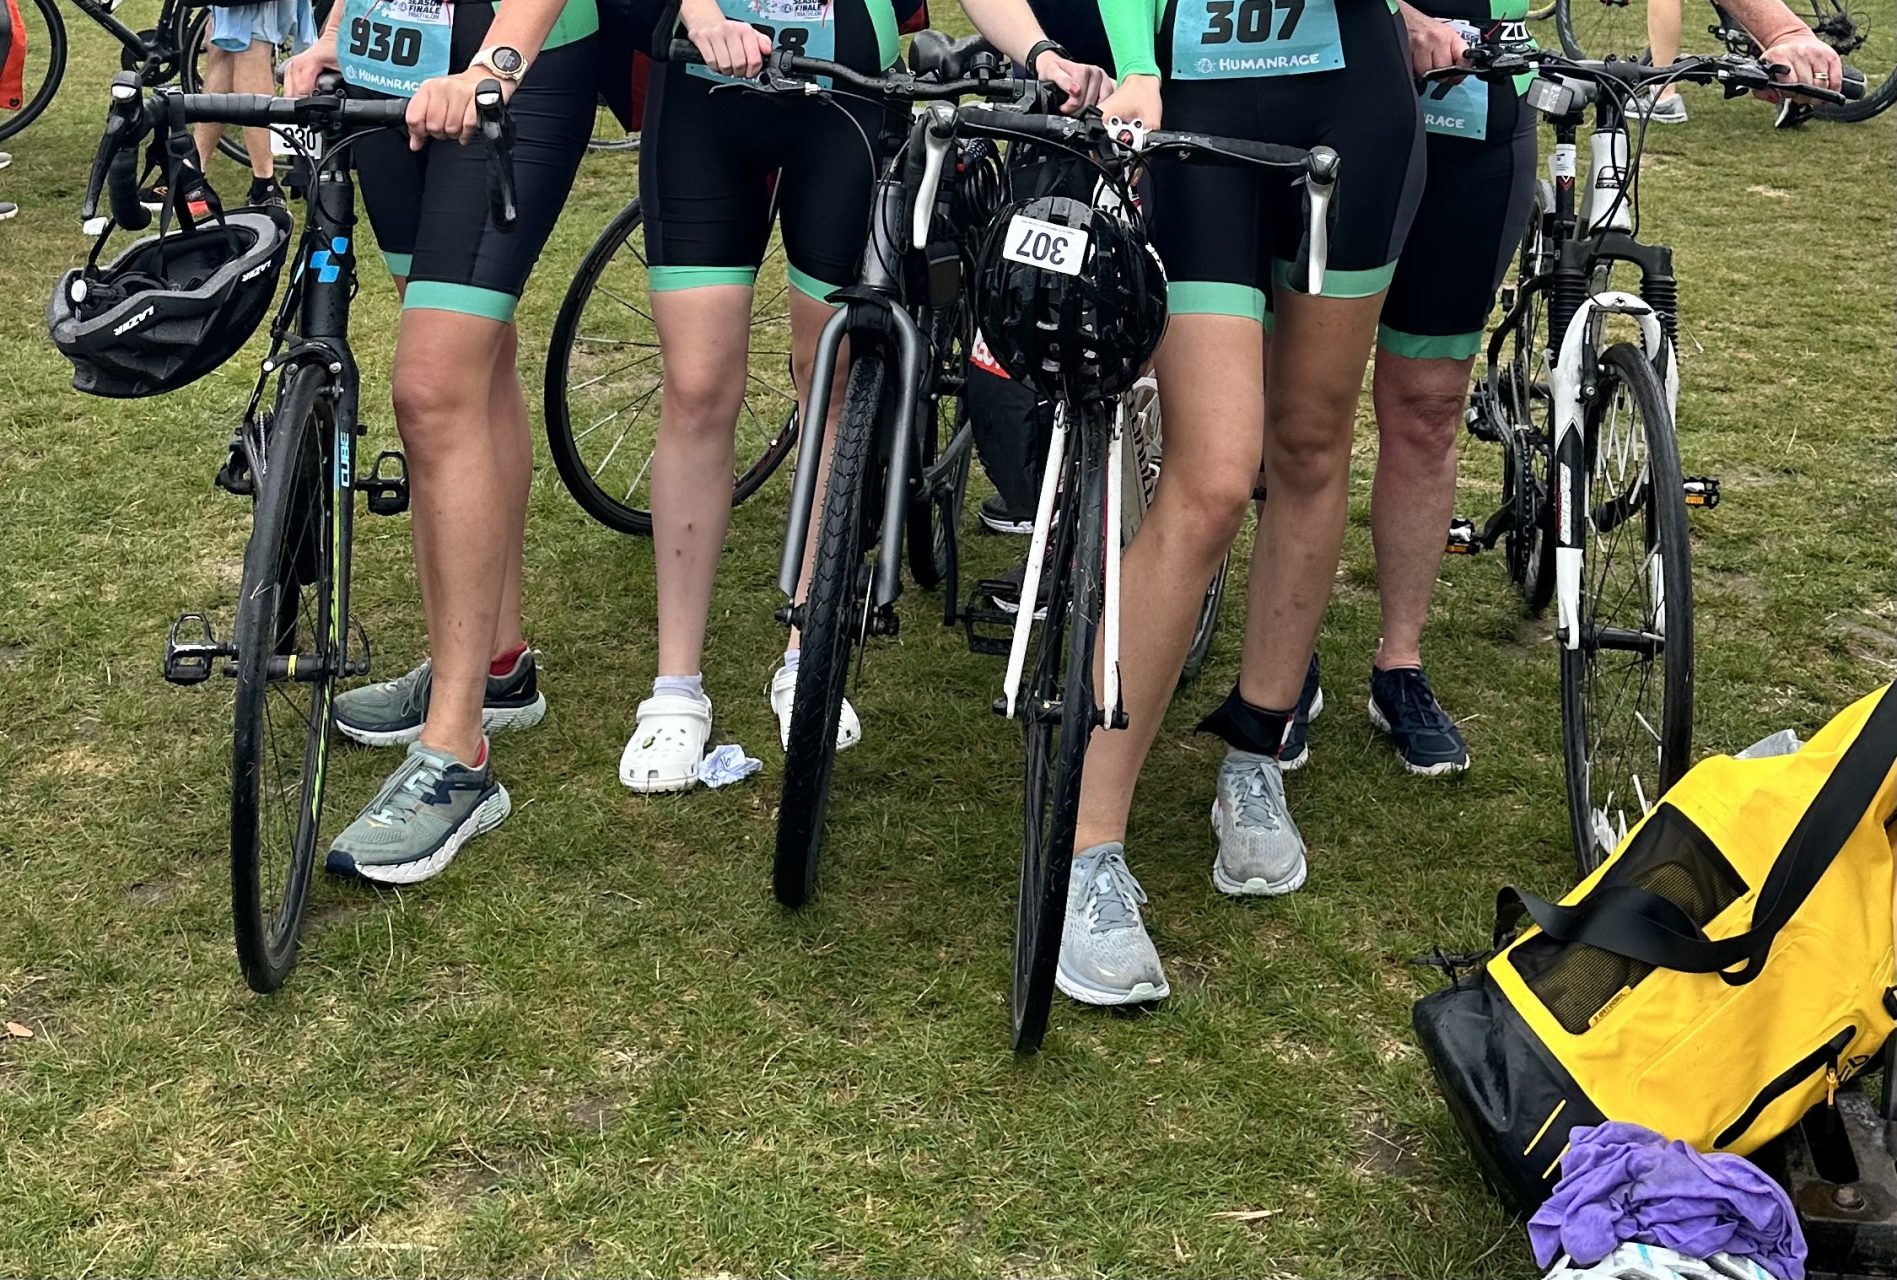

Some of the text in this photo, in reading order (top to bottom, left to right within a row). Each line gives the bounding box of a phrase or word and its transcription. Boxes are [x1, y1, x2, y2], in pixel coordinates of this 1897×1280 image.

[408, 5, 441, 14] FINALE
[350, 17, 422, 67] 930
[1219, 53, 1320, 71] HUMANRACE
[358, 68, 421, 92] HUMANRAC
[283, 127, 316, 151] 930
[1015, 229, 1068, 265] 307
[241, 259, 272, 282] LAZER
[113, 305, 154, 336] LAZER
[341, 431, 350, 488] CUBE
